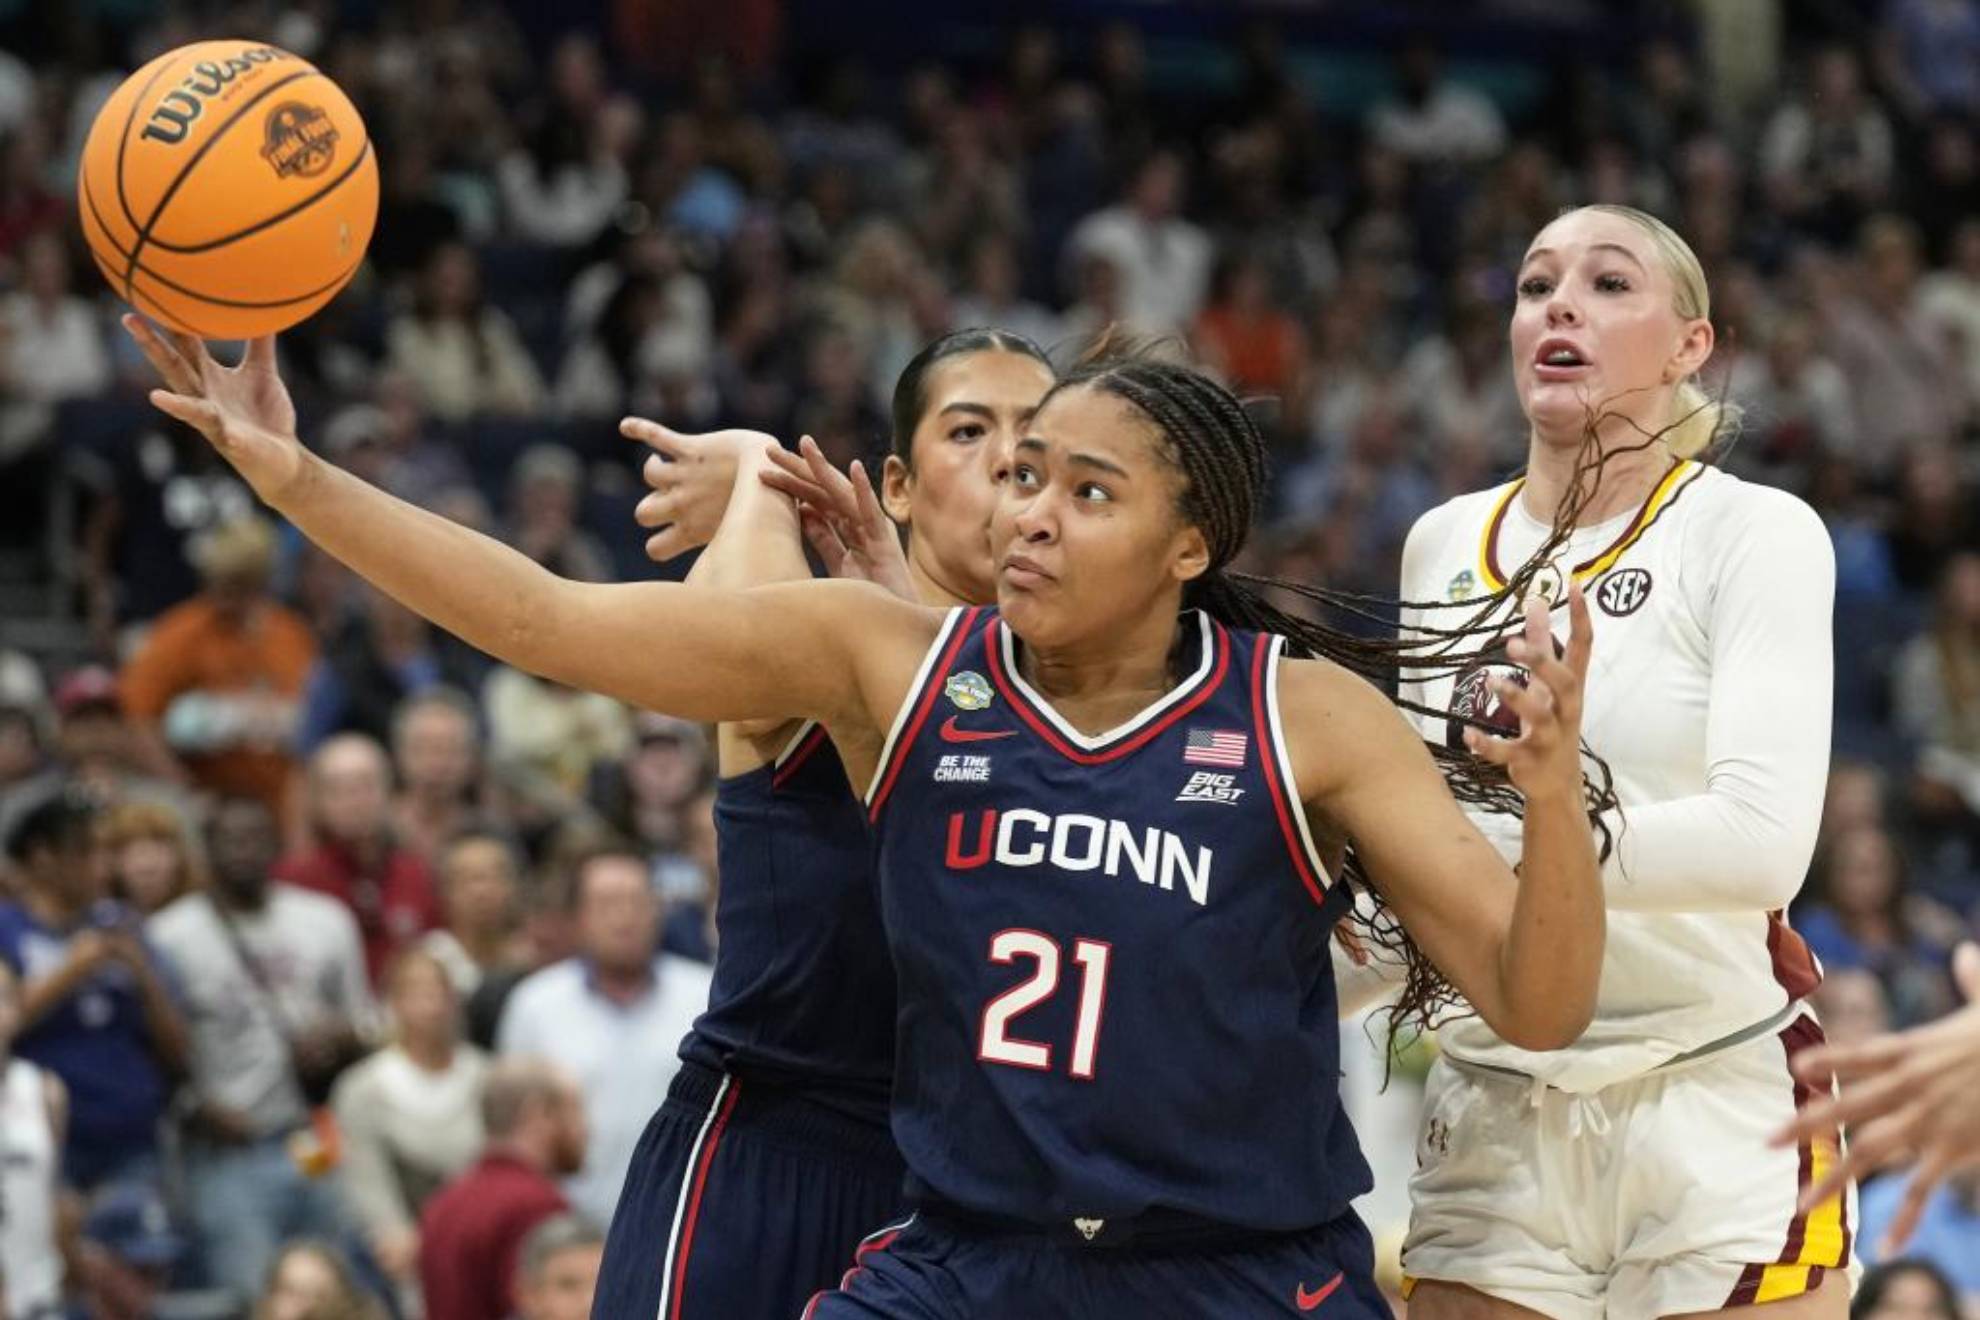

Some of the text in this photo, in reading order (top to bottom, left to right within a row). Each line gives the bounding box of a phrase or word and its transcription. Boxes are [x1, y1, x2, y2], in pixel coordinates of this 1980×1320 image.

[140, 47, 290, 145] Wilson
[1602, 571, 1649, 612] SEC
[933, 766, 991, 782] CHANGE
[940, 755, 991, 768] BE THE
[1179, 784, 1246, 801] EAST
[1188, 771, 1236, 788] BIG
[944, 808, 1213, 906] UCONN
[977, 928, 1112, 1080] 21
